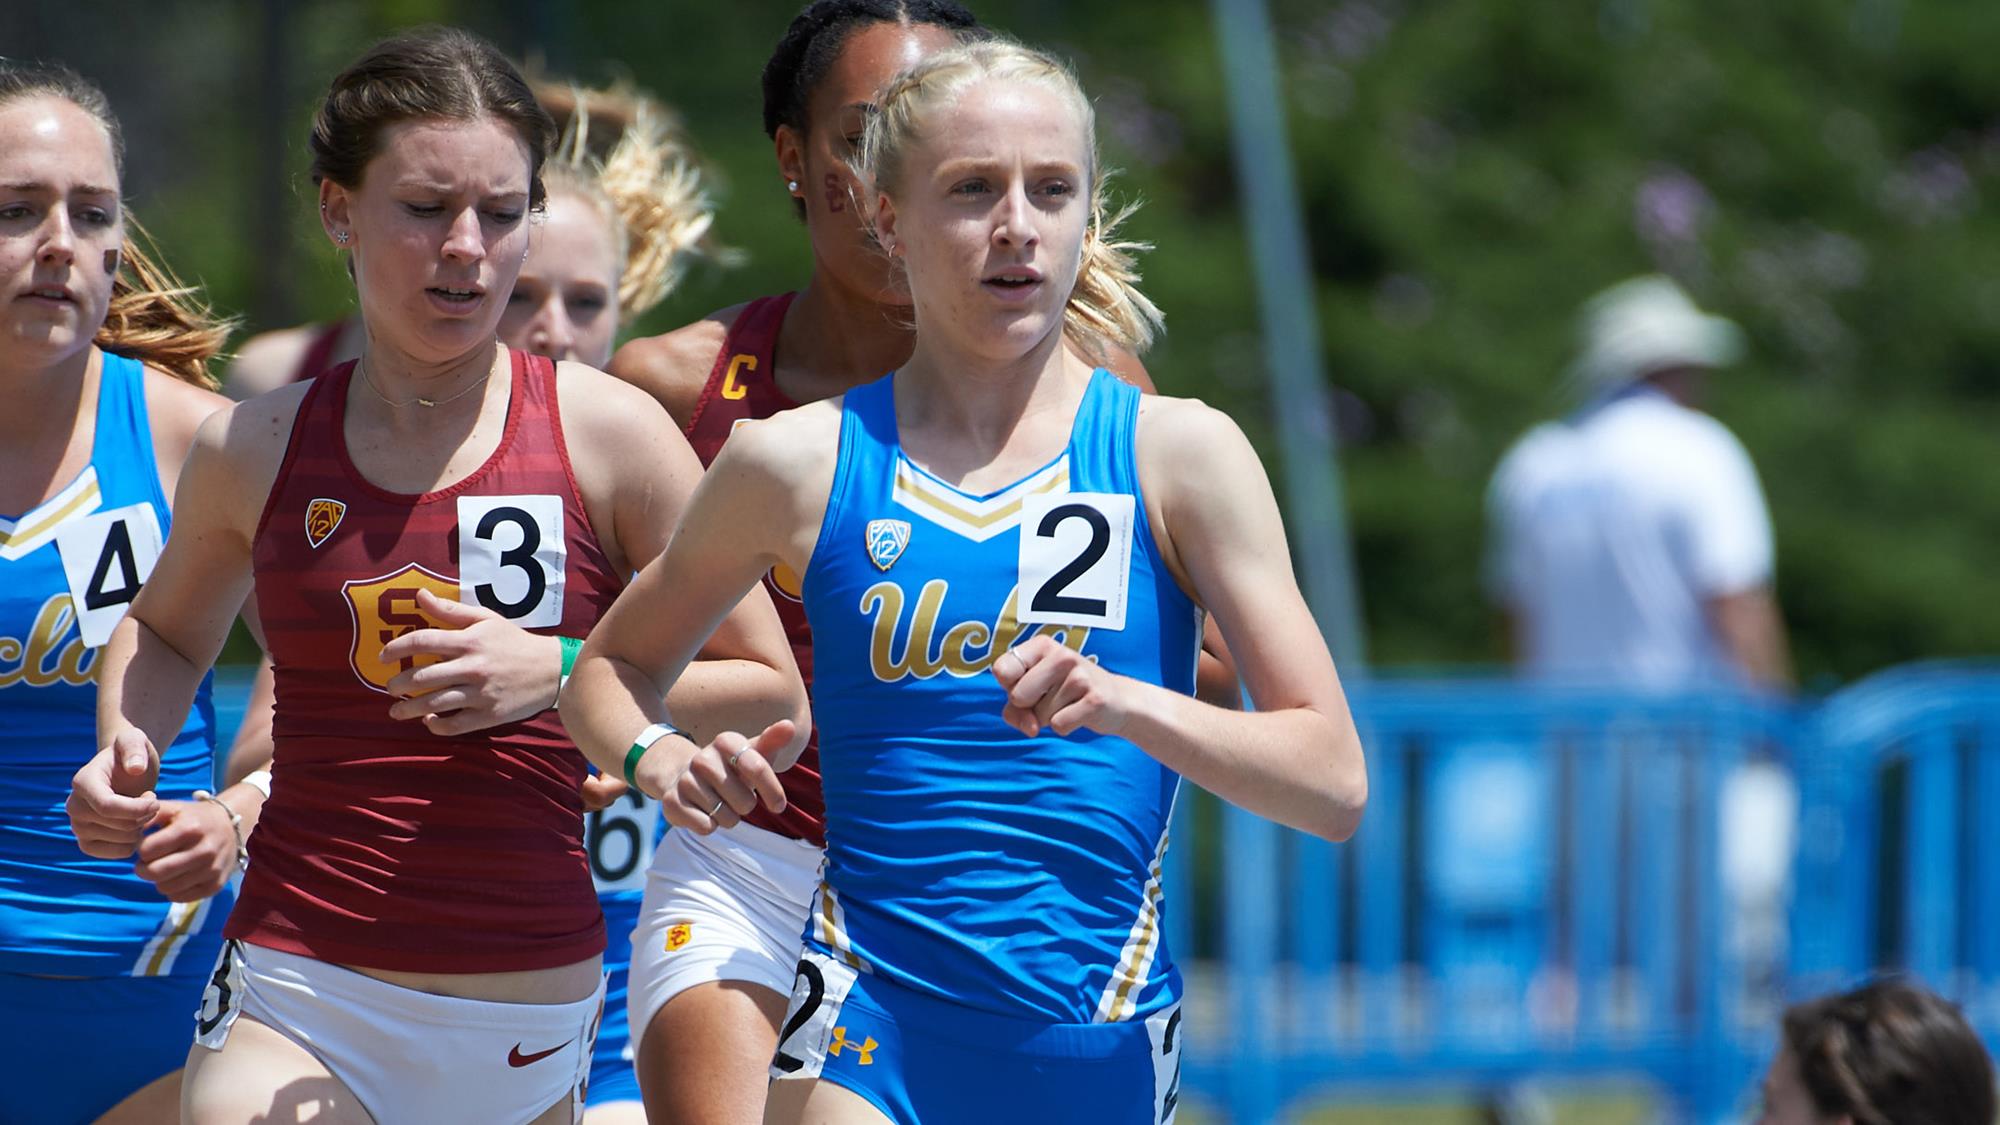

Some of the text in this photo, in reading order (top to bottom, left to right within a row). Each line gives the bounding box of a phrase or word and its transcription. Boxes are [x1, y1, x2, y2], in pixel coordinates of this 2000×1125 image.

[721, 354, 758, 400] C
[84, 519, 144, 611] 4
[310, 519, 330, 537] 12
[474, 506, 546, 619] 3
[876, 540, 896, 560] 12
[1030, 503, 1111, 617] 2
[590, 787, 644, 882] 6
[772, 959, 824, 1073] 2
